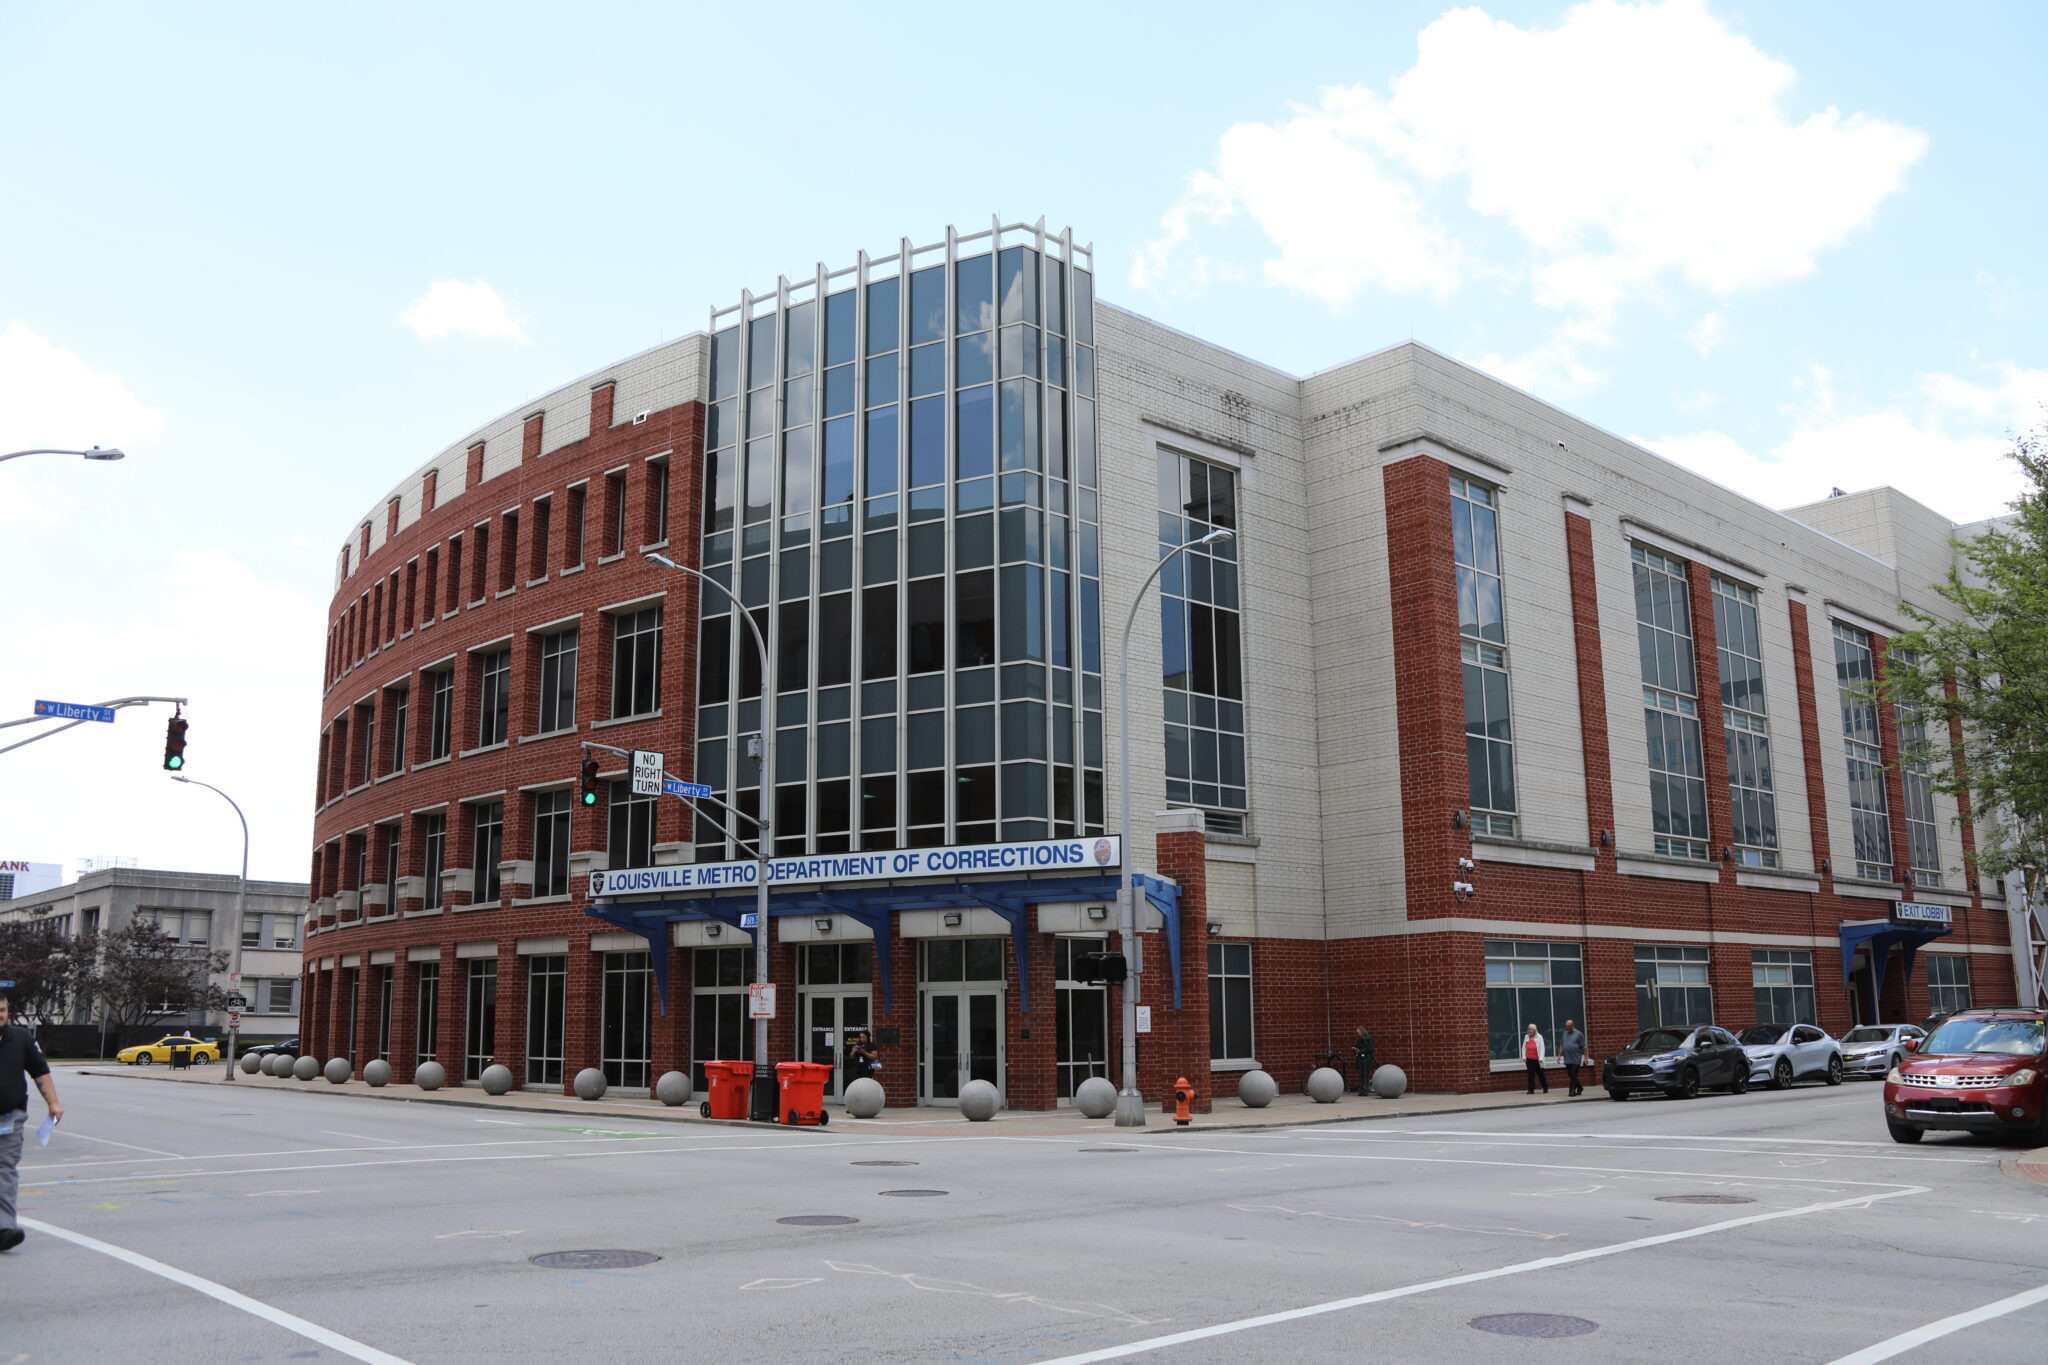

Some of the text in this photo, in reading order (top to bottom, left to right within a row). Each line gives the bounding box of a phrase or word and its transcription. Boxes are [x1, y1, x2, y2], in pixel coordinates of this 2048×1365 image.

[47, 704, 55, 713] W
[56, 703, 100, 721] Liberty
[642, 753, 656, 766] NO
[634, 766, 662, 780] RIGHT
[635, 779, 660, 793] TURN
[673, 782, 701, 797] Liberty
[608, 869, 692, 892] LOUISVILLE
[697, 864, 757, 885] METRO
[893, 853, 920, 873] OF
[926, 843, 1084, 871] CORRECTIONS
[1903, 904, 1945, 920] EXIT LOBBY
[751, 988, 761, 997] NO
